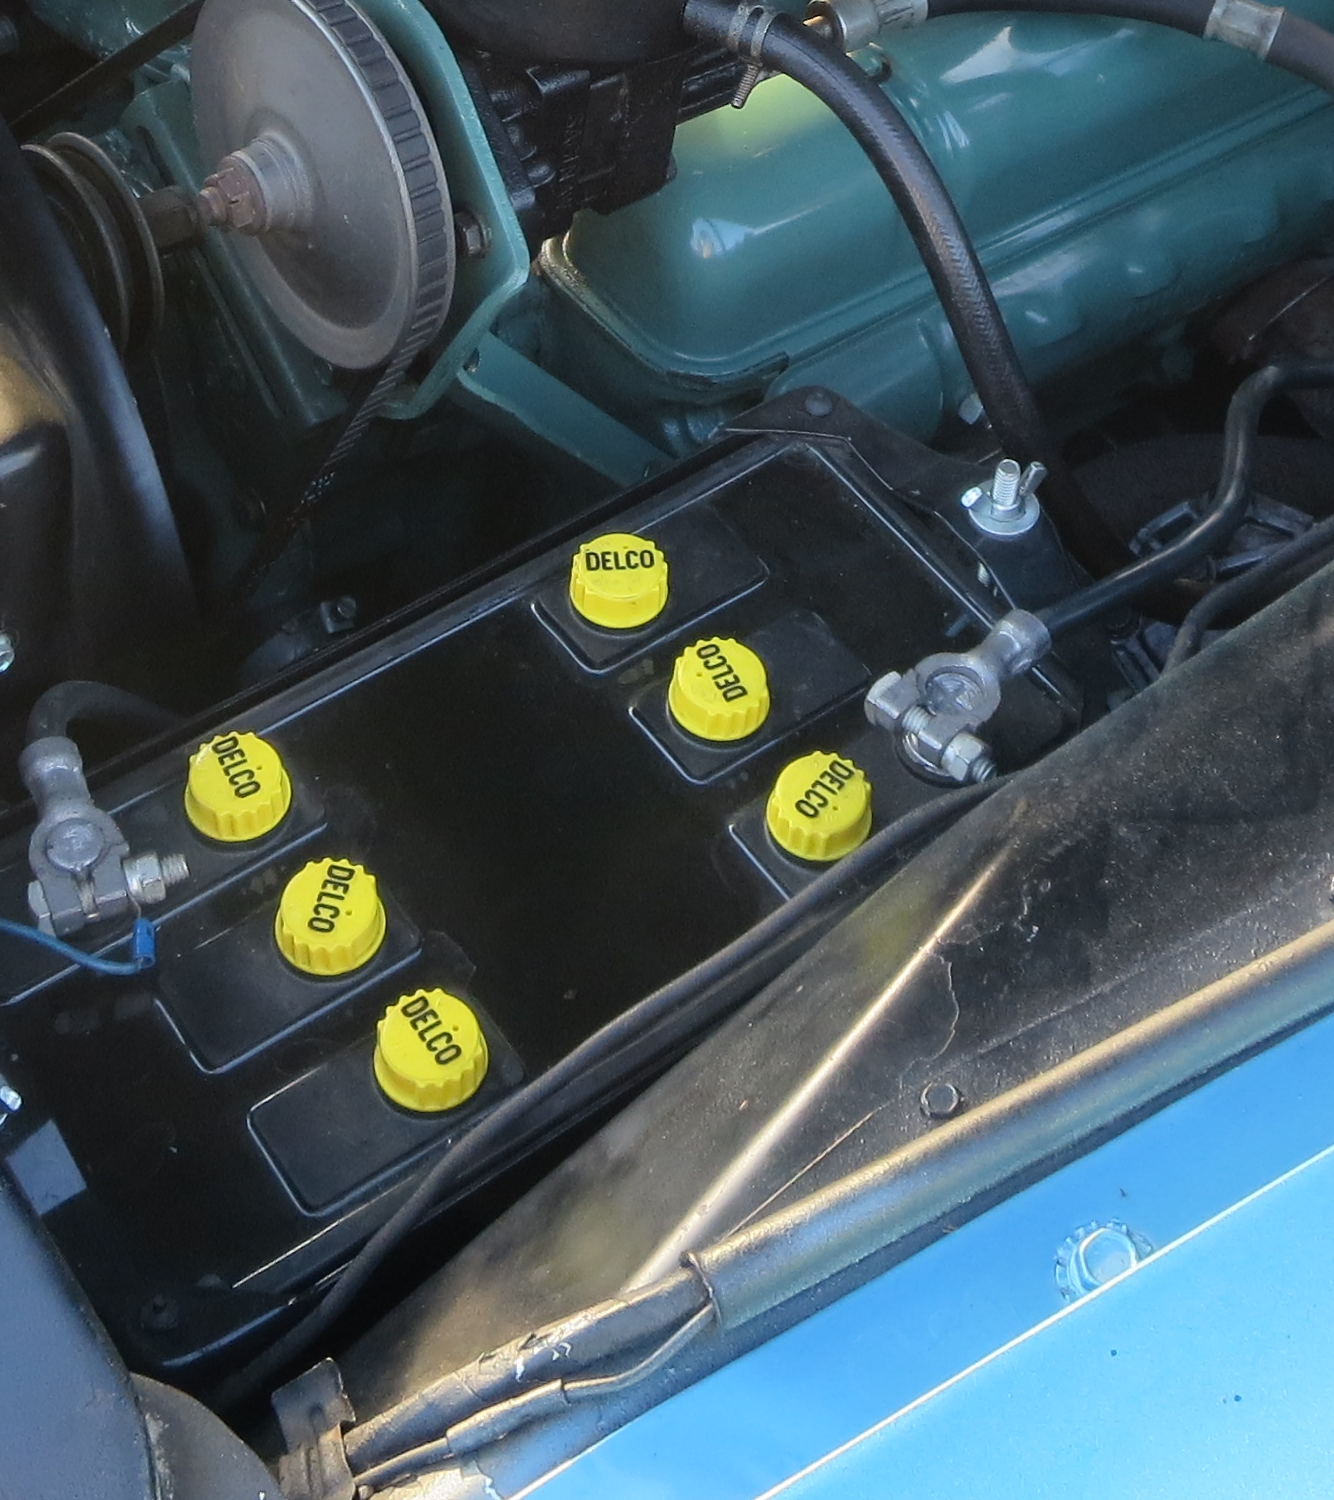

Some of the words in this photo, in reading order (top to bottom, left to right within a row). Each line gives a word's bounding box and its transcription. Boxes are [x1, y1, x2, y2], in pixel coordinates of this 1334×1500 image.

[585, 548, 655, 572] DELCO
[695, 642, 748, 703] DELCO
[210, 735, 262, 800] DELCO
[794, 759, 857, 819] DELCO
[307, 864, 356, 934] DELCO
[400, 994, 463, 1066] DELCO
